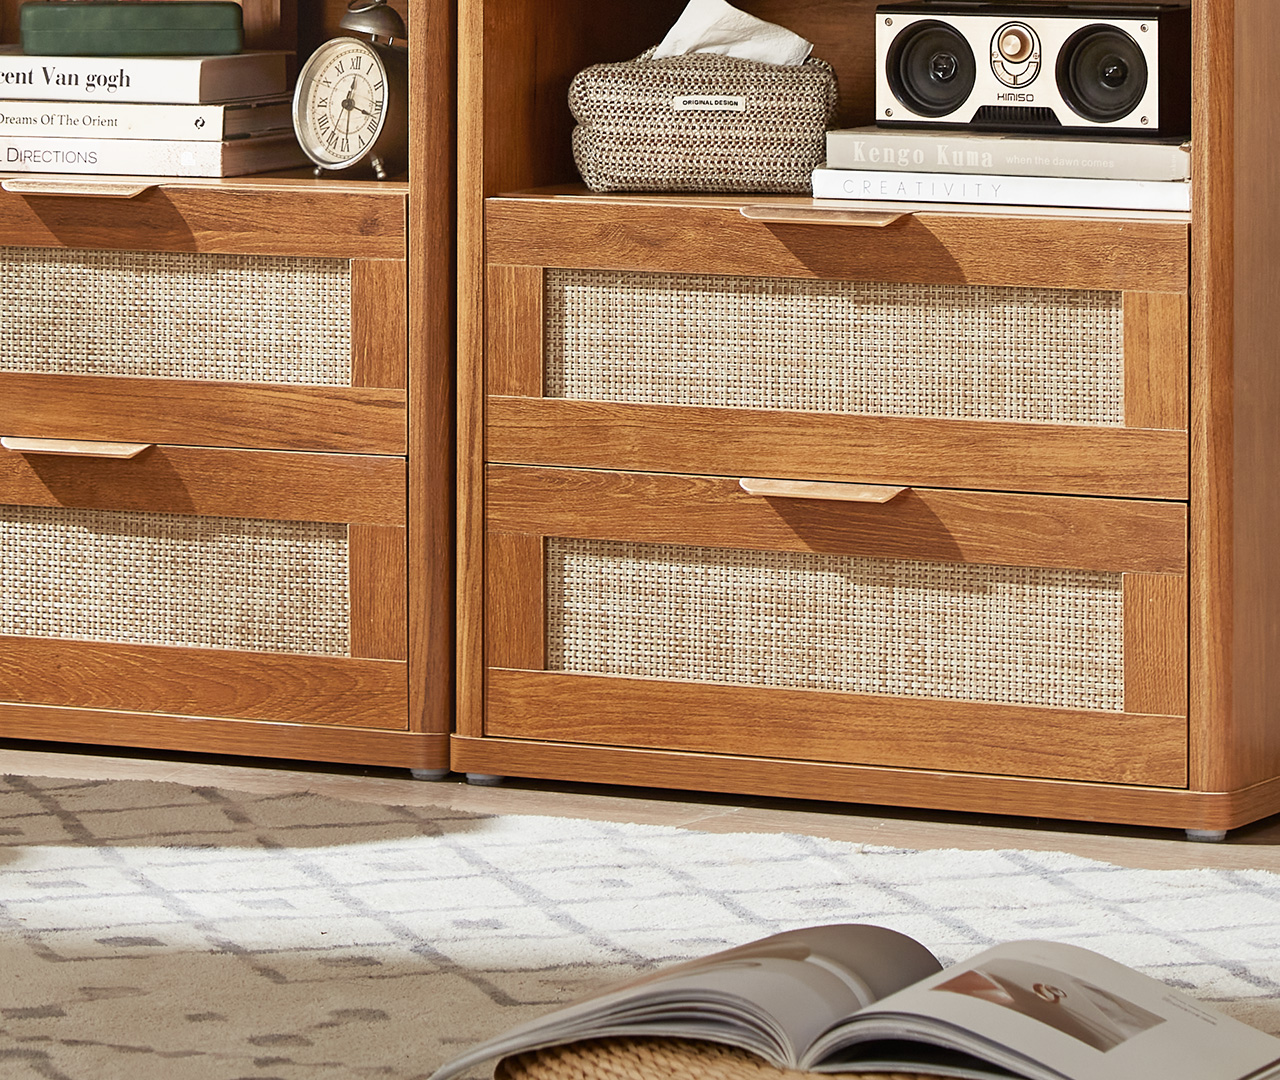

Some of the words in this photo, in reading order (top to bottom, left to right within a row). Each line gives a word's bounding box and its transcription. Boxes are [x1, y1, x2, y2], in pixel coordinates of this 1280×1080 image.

[335, 60, 345, 76] XI
[350, 56, 362, 70] XII
[366, 63, 374, 75] I
[42, 66, 81, 88] Van
[85, 68, 131, 92] gogh
[322, 77, 332, 88] X
[374, 80, 383, 91] II
[317, 97, 328, 108] IX
[996, 92, 1034, 102] HIMISO
[40, 113, 56, 127] Of
[57, 114, 80, 127] The
[82, 114, 118, 128] Orient
[317, 113, 331, 136] VIII
[358, 135, 366, 149] V
[6, 146, 98, 165] DIRECTIONS
[853, 140, 926, 168] Kengo
[936, 144, 994, 168] Kuma
[1006, 154, 1032, 165] when
[1034, 155, 1050, 166] the
[1052, 156, 1079, 167] dawn
[1081, 158, 1114, 168] comes
[842, 179, 1003, 198] CREATIVITY
